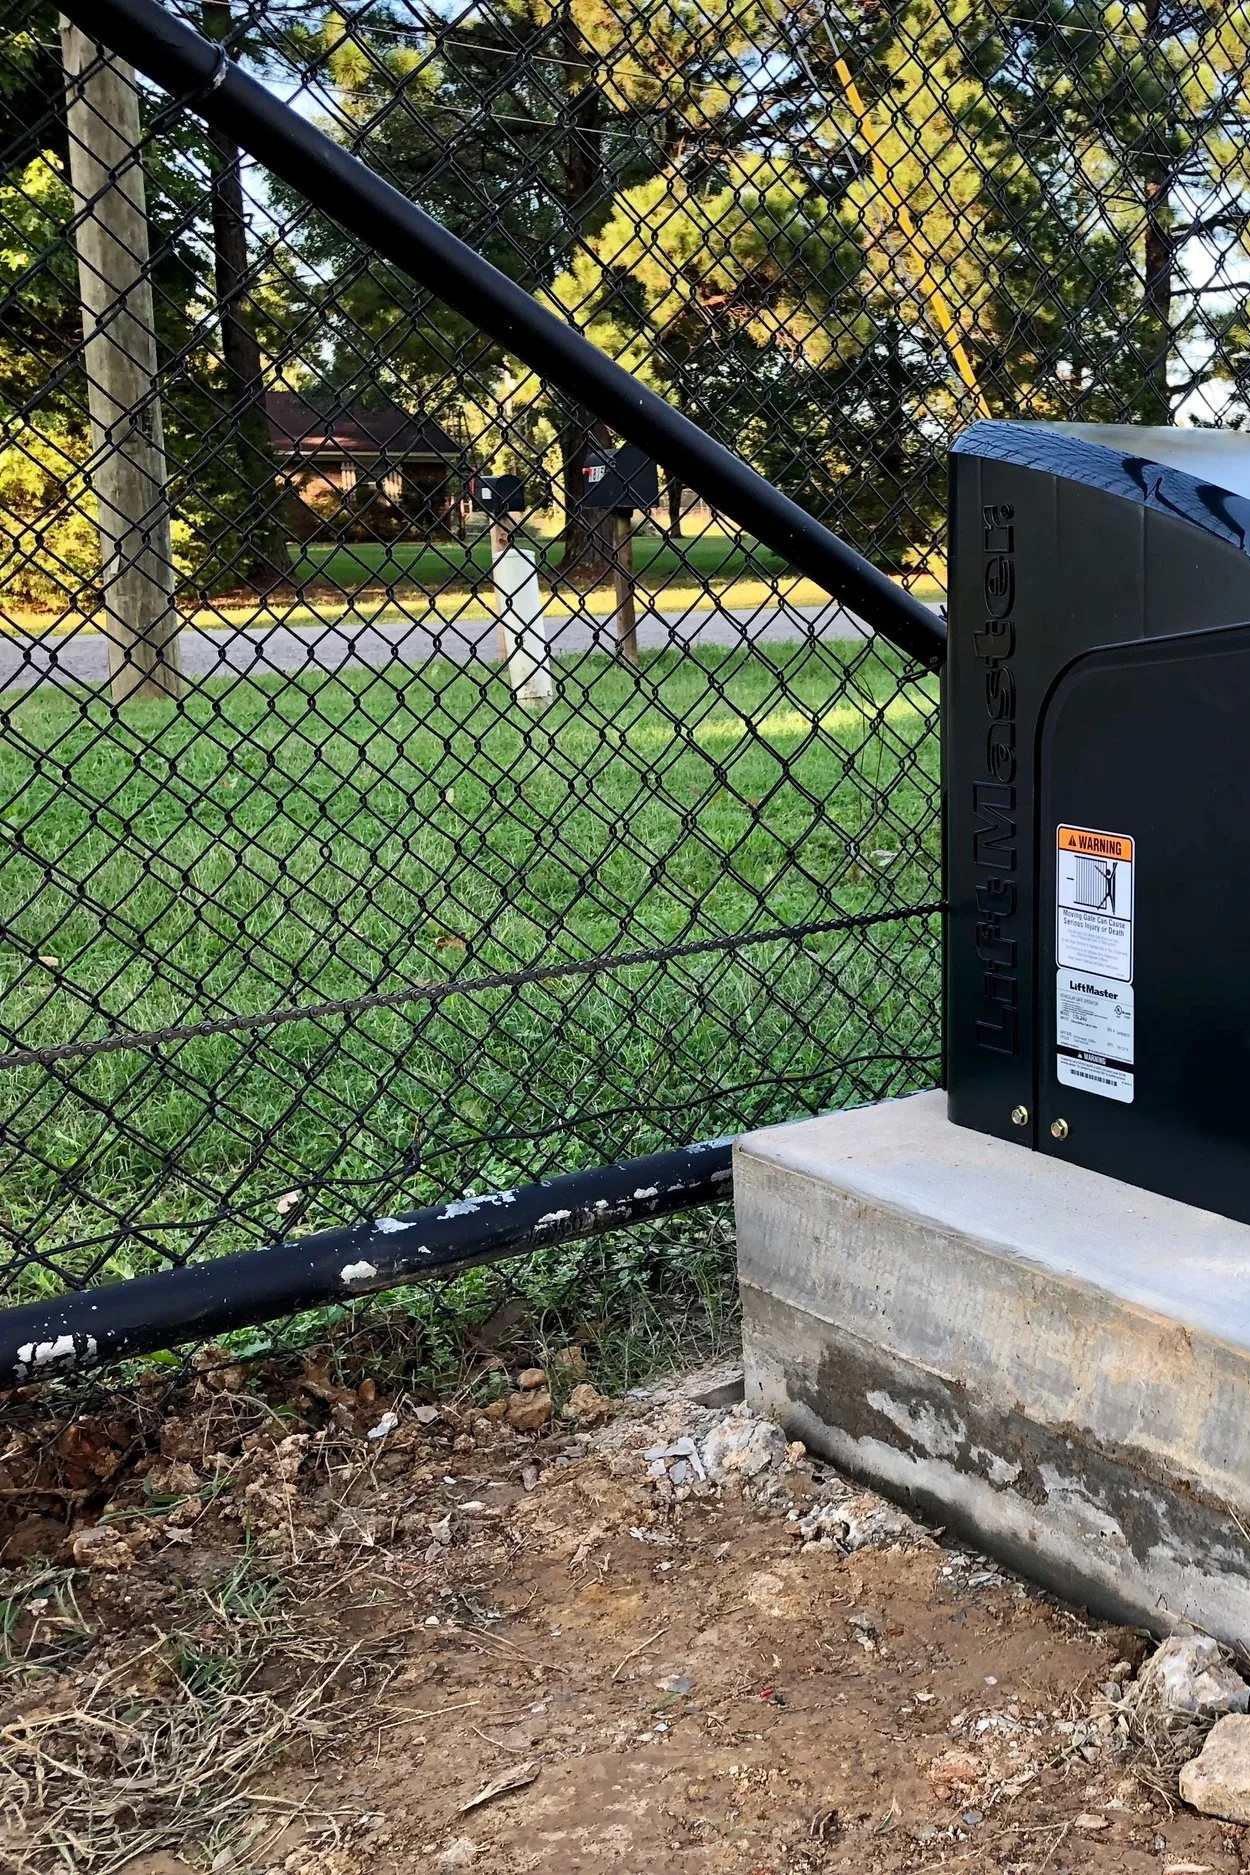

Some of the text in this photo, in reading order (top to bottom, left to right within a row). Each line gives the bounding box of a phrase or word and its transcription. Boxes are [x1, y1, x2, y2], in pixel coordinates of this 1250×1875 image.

[1078, 835, 1122, 856] WARNING
[1063, 909, 1126, 930] Moving Gate Can Cause
[1063, 916, 1084, 928] Serious
[1085, 922, 1100, 933] Injury
[1108, 927, 1125, 937] Death
[1083, 1052, 1106, 1065] WARNING
